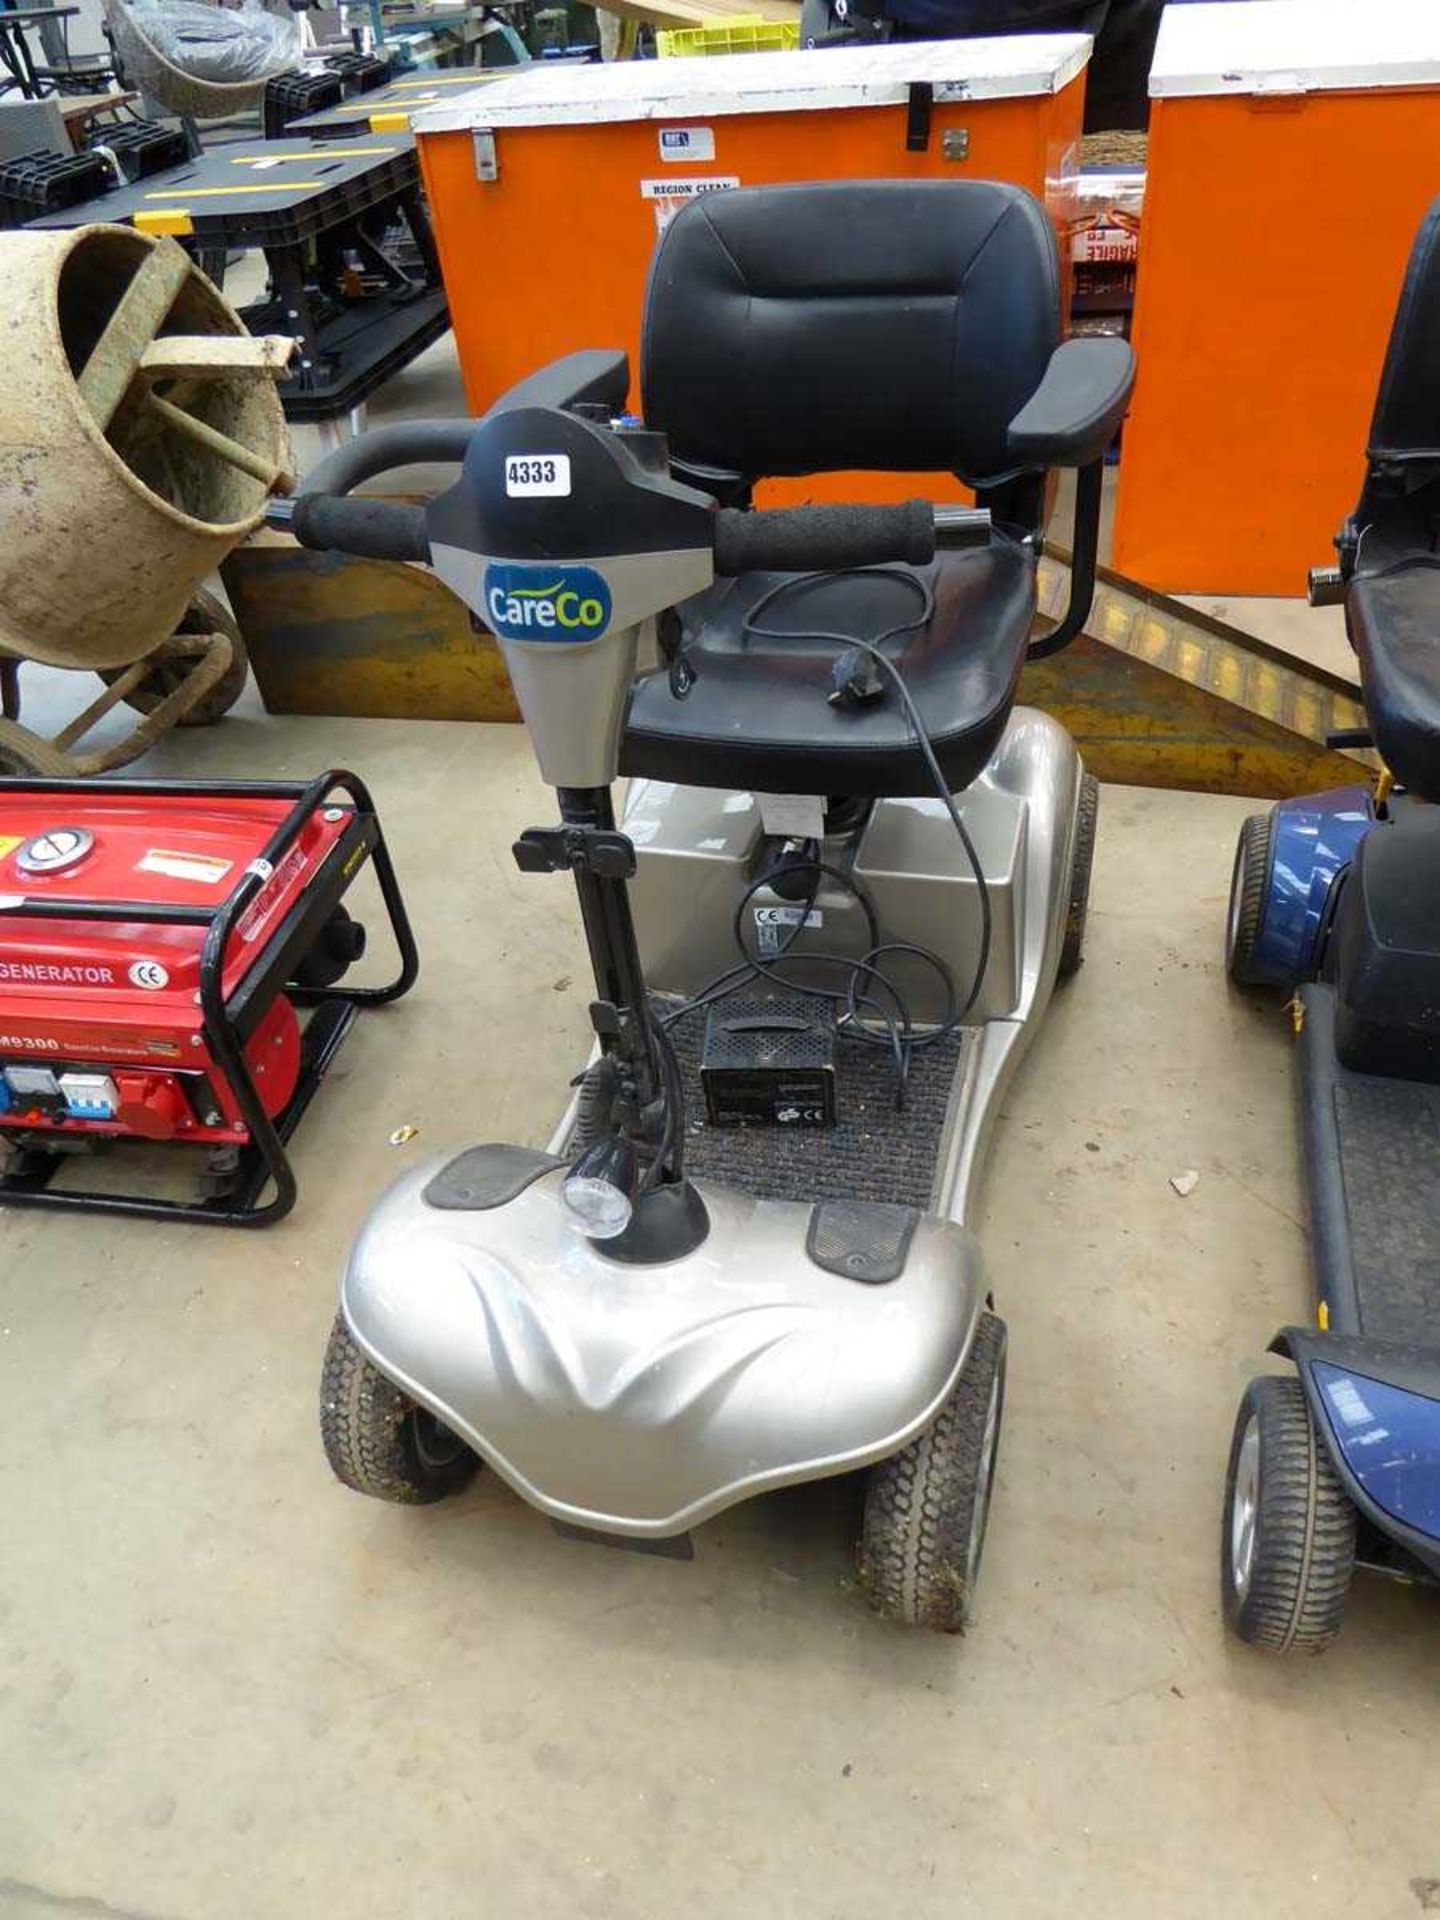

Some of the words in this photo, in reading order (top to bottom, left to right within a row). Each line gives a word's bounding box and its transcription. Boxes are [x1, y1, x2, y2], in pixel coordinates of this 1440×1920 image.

[508, 461, 556, 484] 4333
[490, 587, 604, 627] CareCo
[0, 963, 114, 983] GENERATOR
